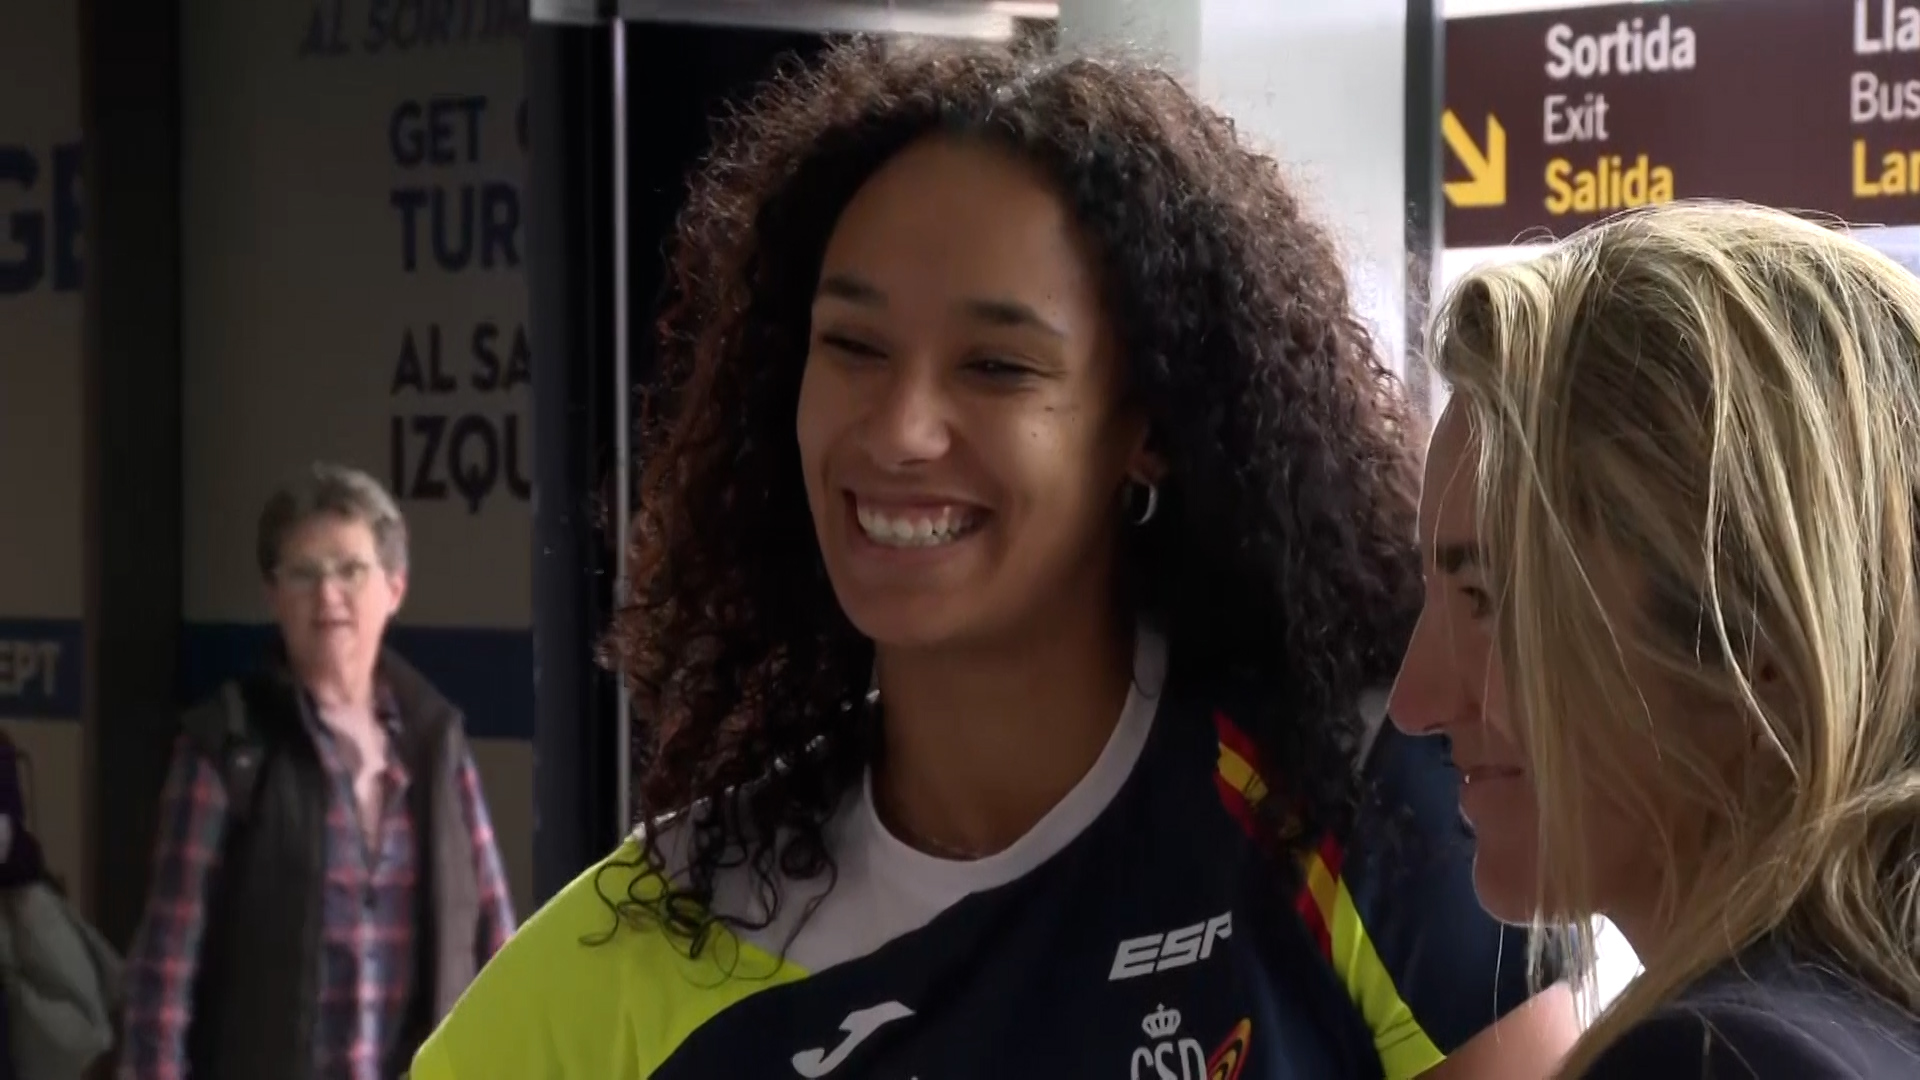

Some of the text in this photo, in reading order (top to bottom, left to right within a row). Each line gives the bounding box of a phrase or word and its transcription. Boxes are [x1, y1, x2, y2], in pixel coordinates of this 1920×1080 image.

[1545, 14, 1696, 79] Sortida
[1854, 0, 1920, 53] Lla
[1543, 93, 1609, 144] Exit
[1850, 70, 1920, 122] Bus
[388, 95, 487, 169] GET
[1545, 154, 1674, 215] Salida
[389, 180, 520, 274] TUR
[390, 321, 531, 397] AL SA
[391, 411, 531, 515] IZQU
[1107, 909, 1233, 982] ESP
